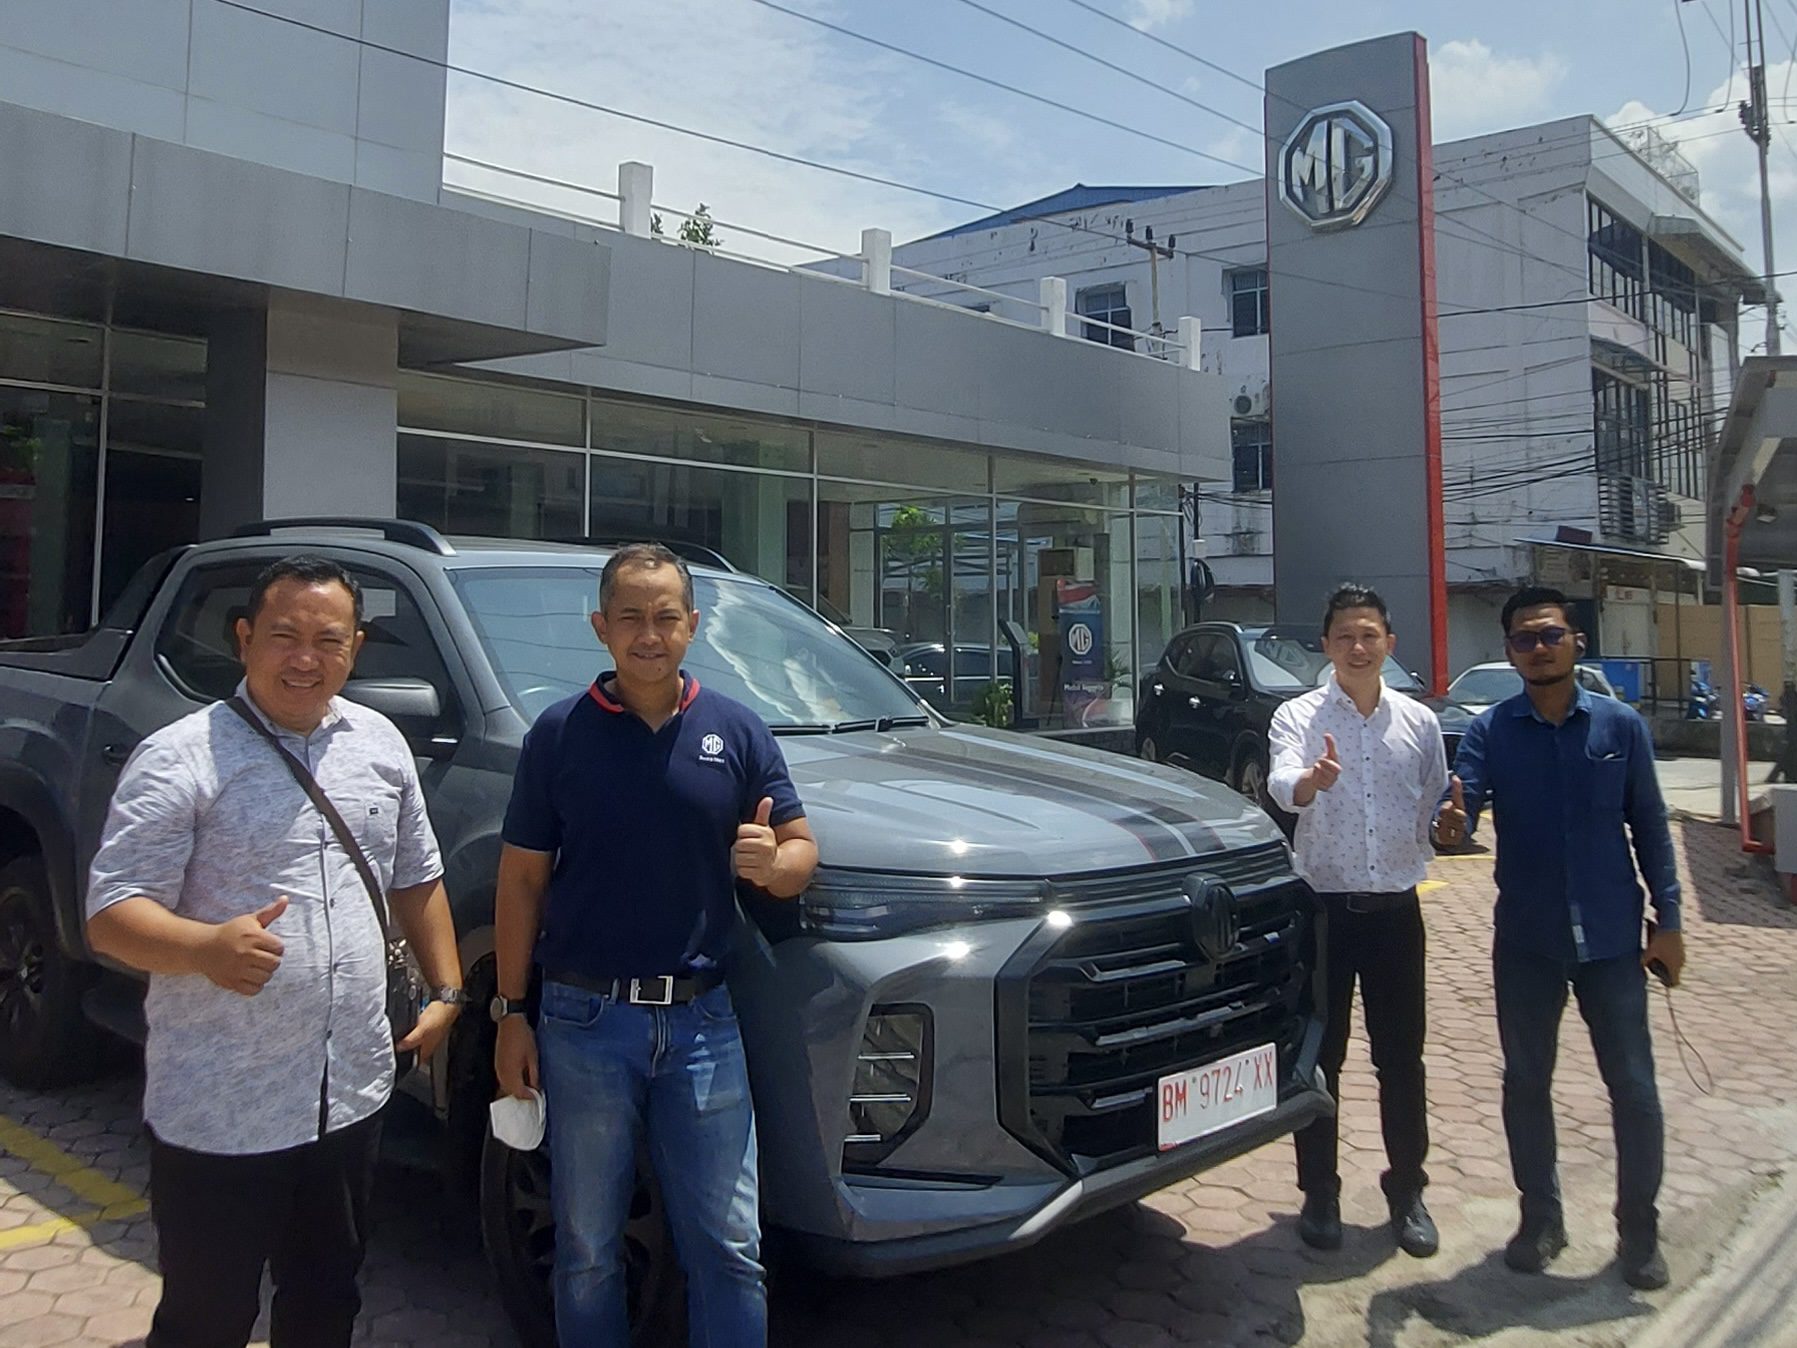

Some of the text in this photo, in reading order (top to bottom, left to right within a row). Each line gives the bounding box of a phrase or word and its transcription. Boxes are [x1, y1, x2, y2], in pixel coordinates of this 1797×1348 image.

[1290, 116, 1376, 215] MG
[1070, 626, 1091, 652] MG
[703, 734, 722, 753] MG
[1162, 1051, 1273, 1122] BM 9724 XX
